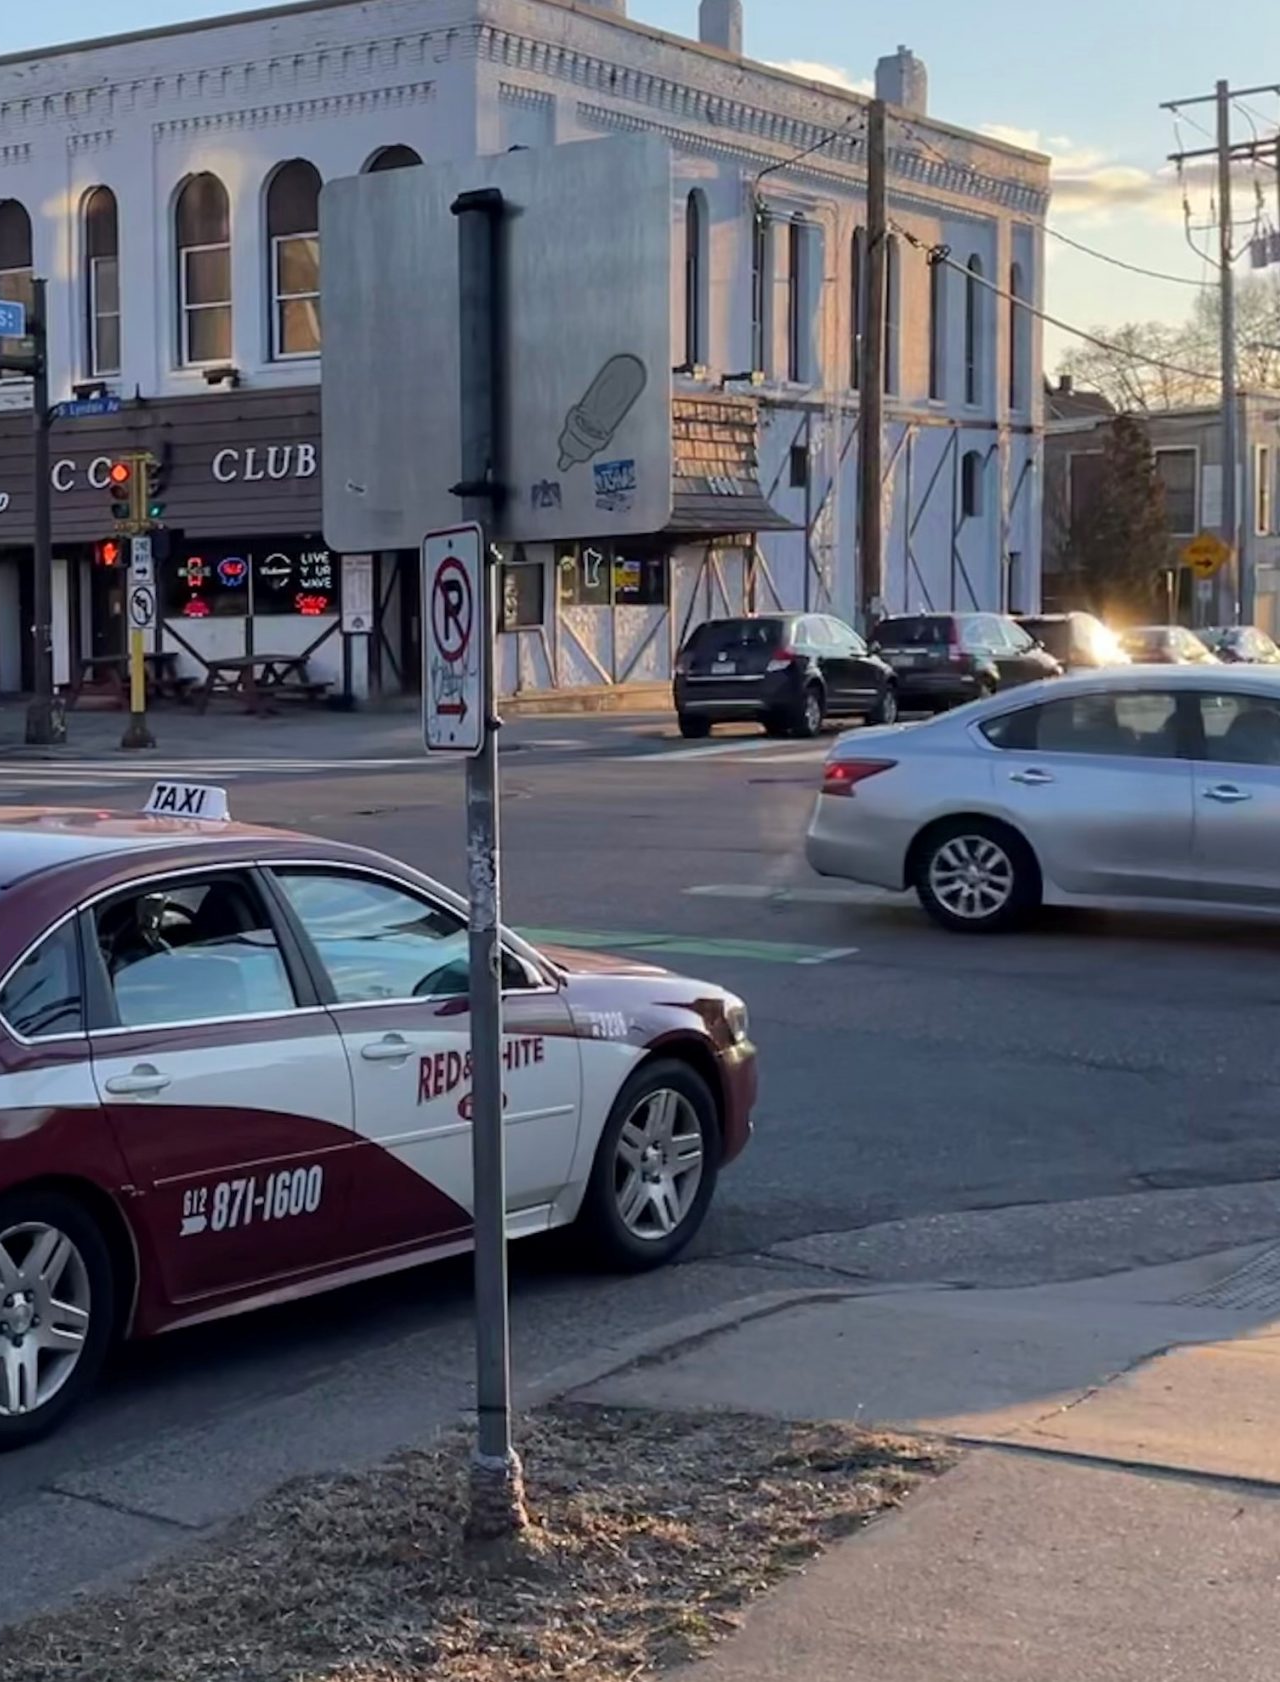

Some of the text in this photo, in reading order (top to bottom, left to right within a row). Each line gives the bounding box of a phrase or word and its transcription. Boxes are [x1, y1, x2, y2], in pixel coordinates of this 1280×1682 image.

[212, 444, 316, 482] CLUB
[300, 551, 330, 565] LIVE
[300, 577, 332, 589] WAVE
[153, 786, 206, 814] TAXI
[183, 1165, 323, 1231] 612 871-1600
